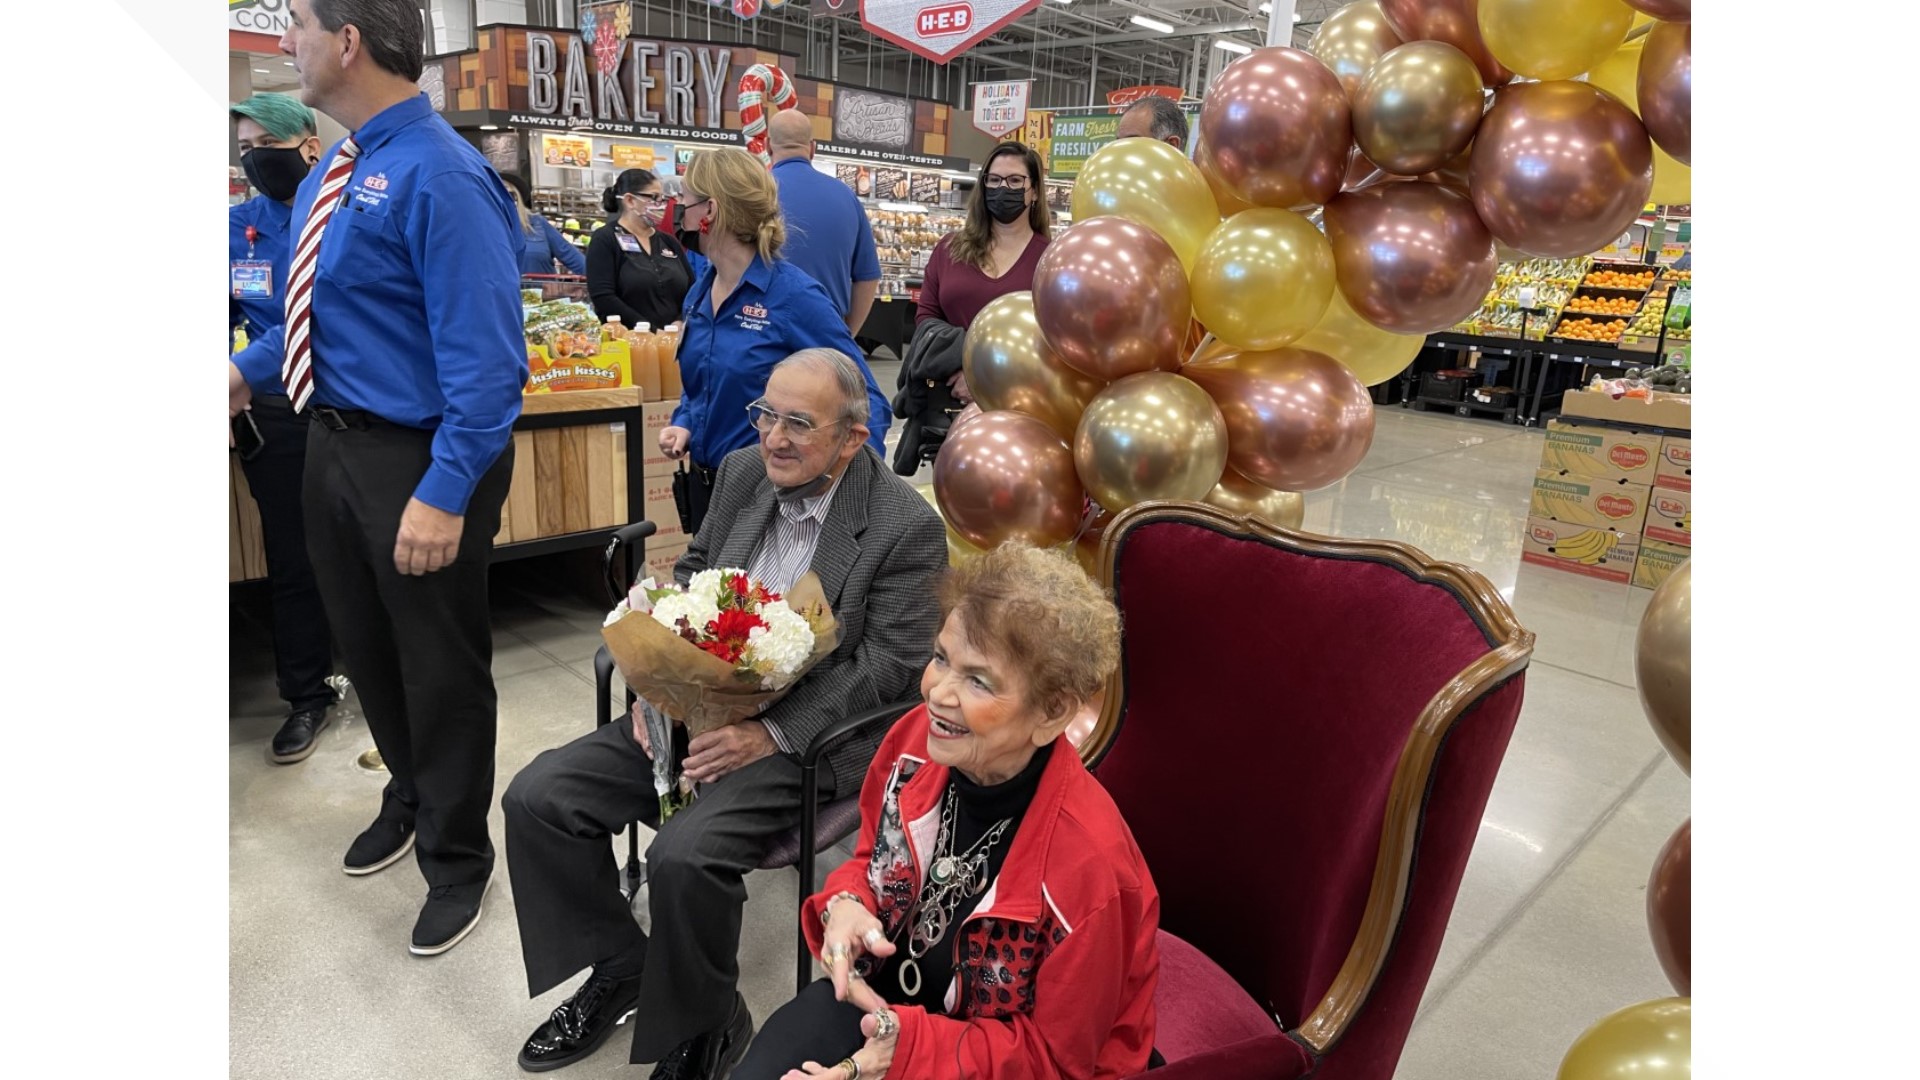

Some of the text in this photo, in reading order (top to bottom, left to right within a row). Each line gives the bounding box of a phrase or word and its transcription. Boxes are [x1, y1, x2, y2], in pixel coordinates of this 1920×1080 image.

[526, 31, 731, 129] BAKERY
[982, 84, 1020, 98] HOLIDAYS
[982, 107, 1017, 121] TOGETHER
[510, 114, 738, 141] ALWAYS Fresh OVEN BAKED GOODS
[1055, 120, 1117, 138] FARM Fresh
[817, 143, 943, 166] BAKERS ARE OVEN-TESTED
[1053, 141, 1100, 156] FRESHLY
[531, 368, 571, 384] kishu
[574, 366, 615, 378] kisses
[1550, 432, 1591, 444] Premium
[1548, 441, 1595, 455] BANANAS
[1611, 450, 1647, 461] Del Monte
[1537, 480, 1578, 492] Premium
[1536, 490, 1582, 503] BANANAS
[1599, 499, 1611, 508] Del
[1660, 500, 1684, 513] Dole
[1534, 528, 1555, 540] Dole
